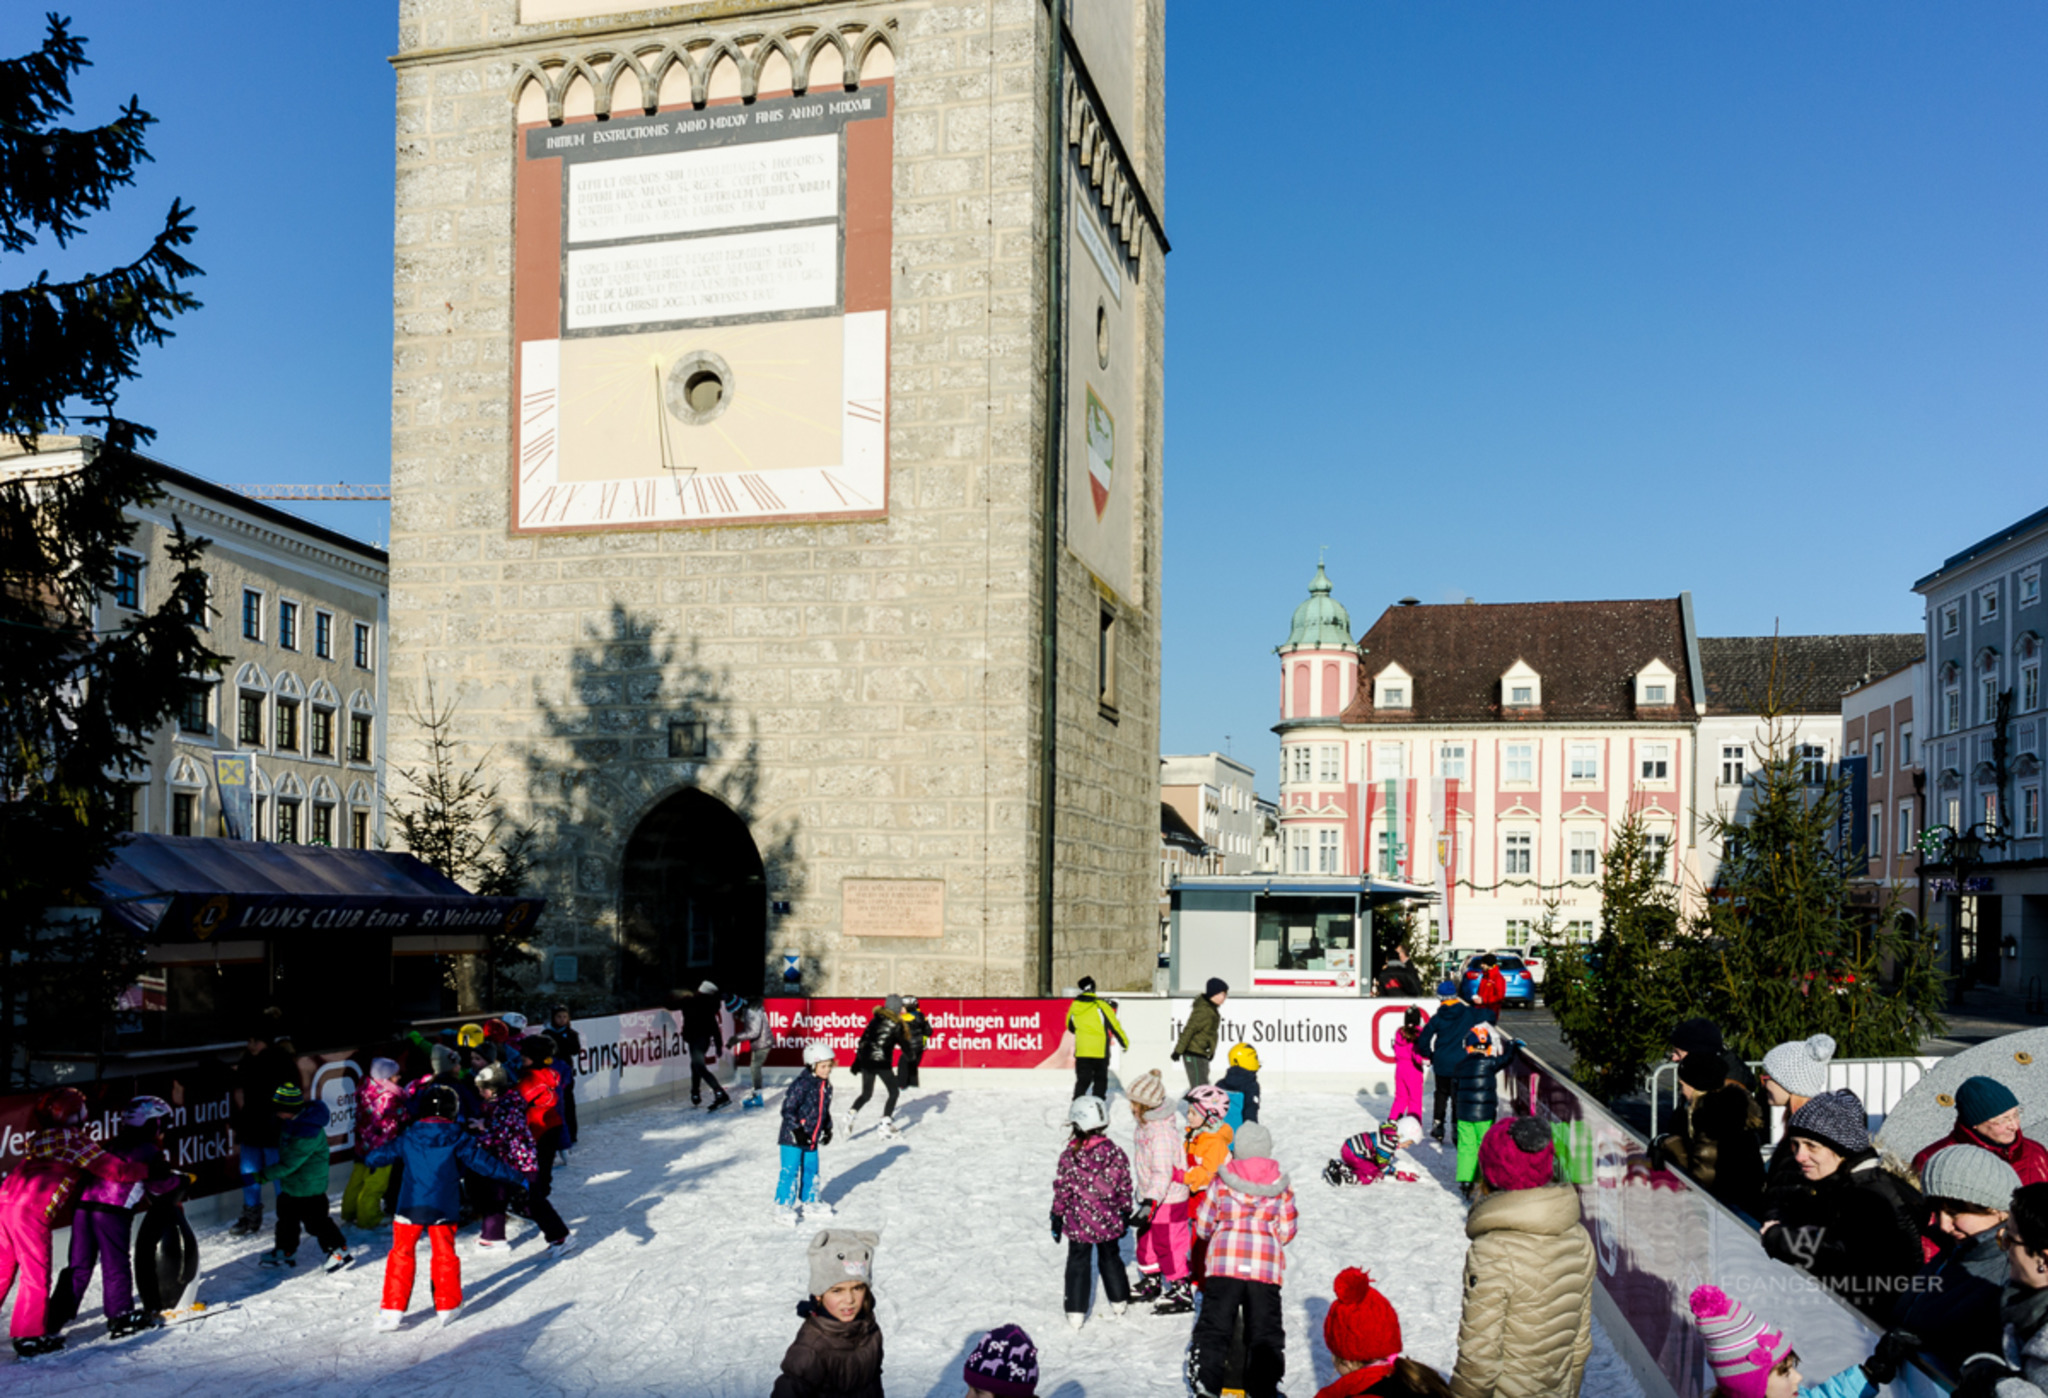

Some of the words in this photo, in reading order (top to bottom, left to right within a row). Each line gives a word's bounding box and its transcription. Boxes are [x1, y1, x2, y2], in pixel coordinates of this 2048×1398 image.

[675, 117, 707, 134] ANNO
[756, 109, 784, 125] FINIS
[788, 104, 824, 120] ANNO
[239, 905, 307, 928] LIONS
[312, 908, 364, 928] CLUB
[365, 908, 410, 927] Enns
[792, 1011, 867, 1032] Angebote
[1009, 1012, 1040, 1028] und
[1252, 1018, 1348, 1043] Solutions
[948, 1033, 992, 1050] einen
[997, 1033, 1043, 1050] Klick!
[195, 1092, 230, 1123] und
[179, 1129, 234, 1166] Klick!
